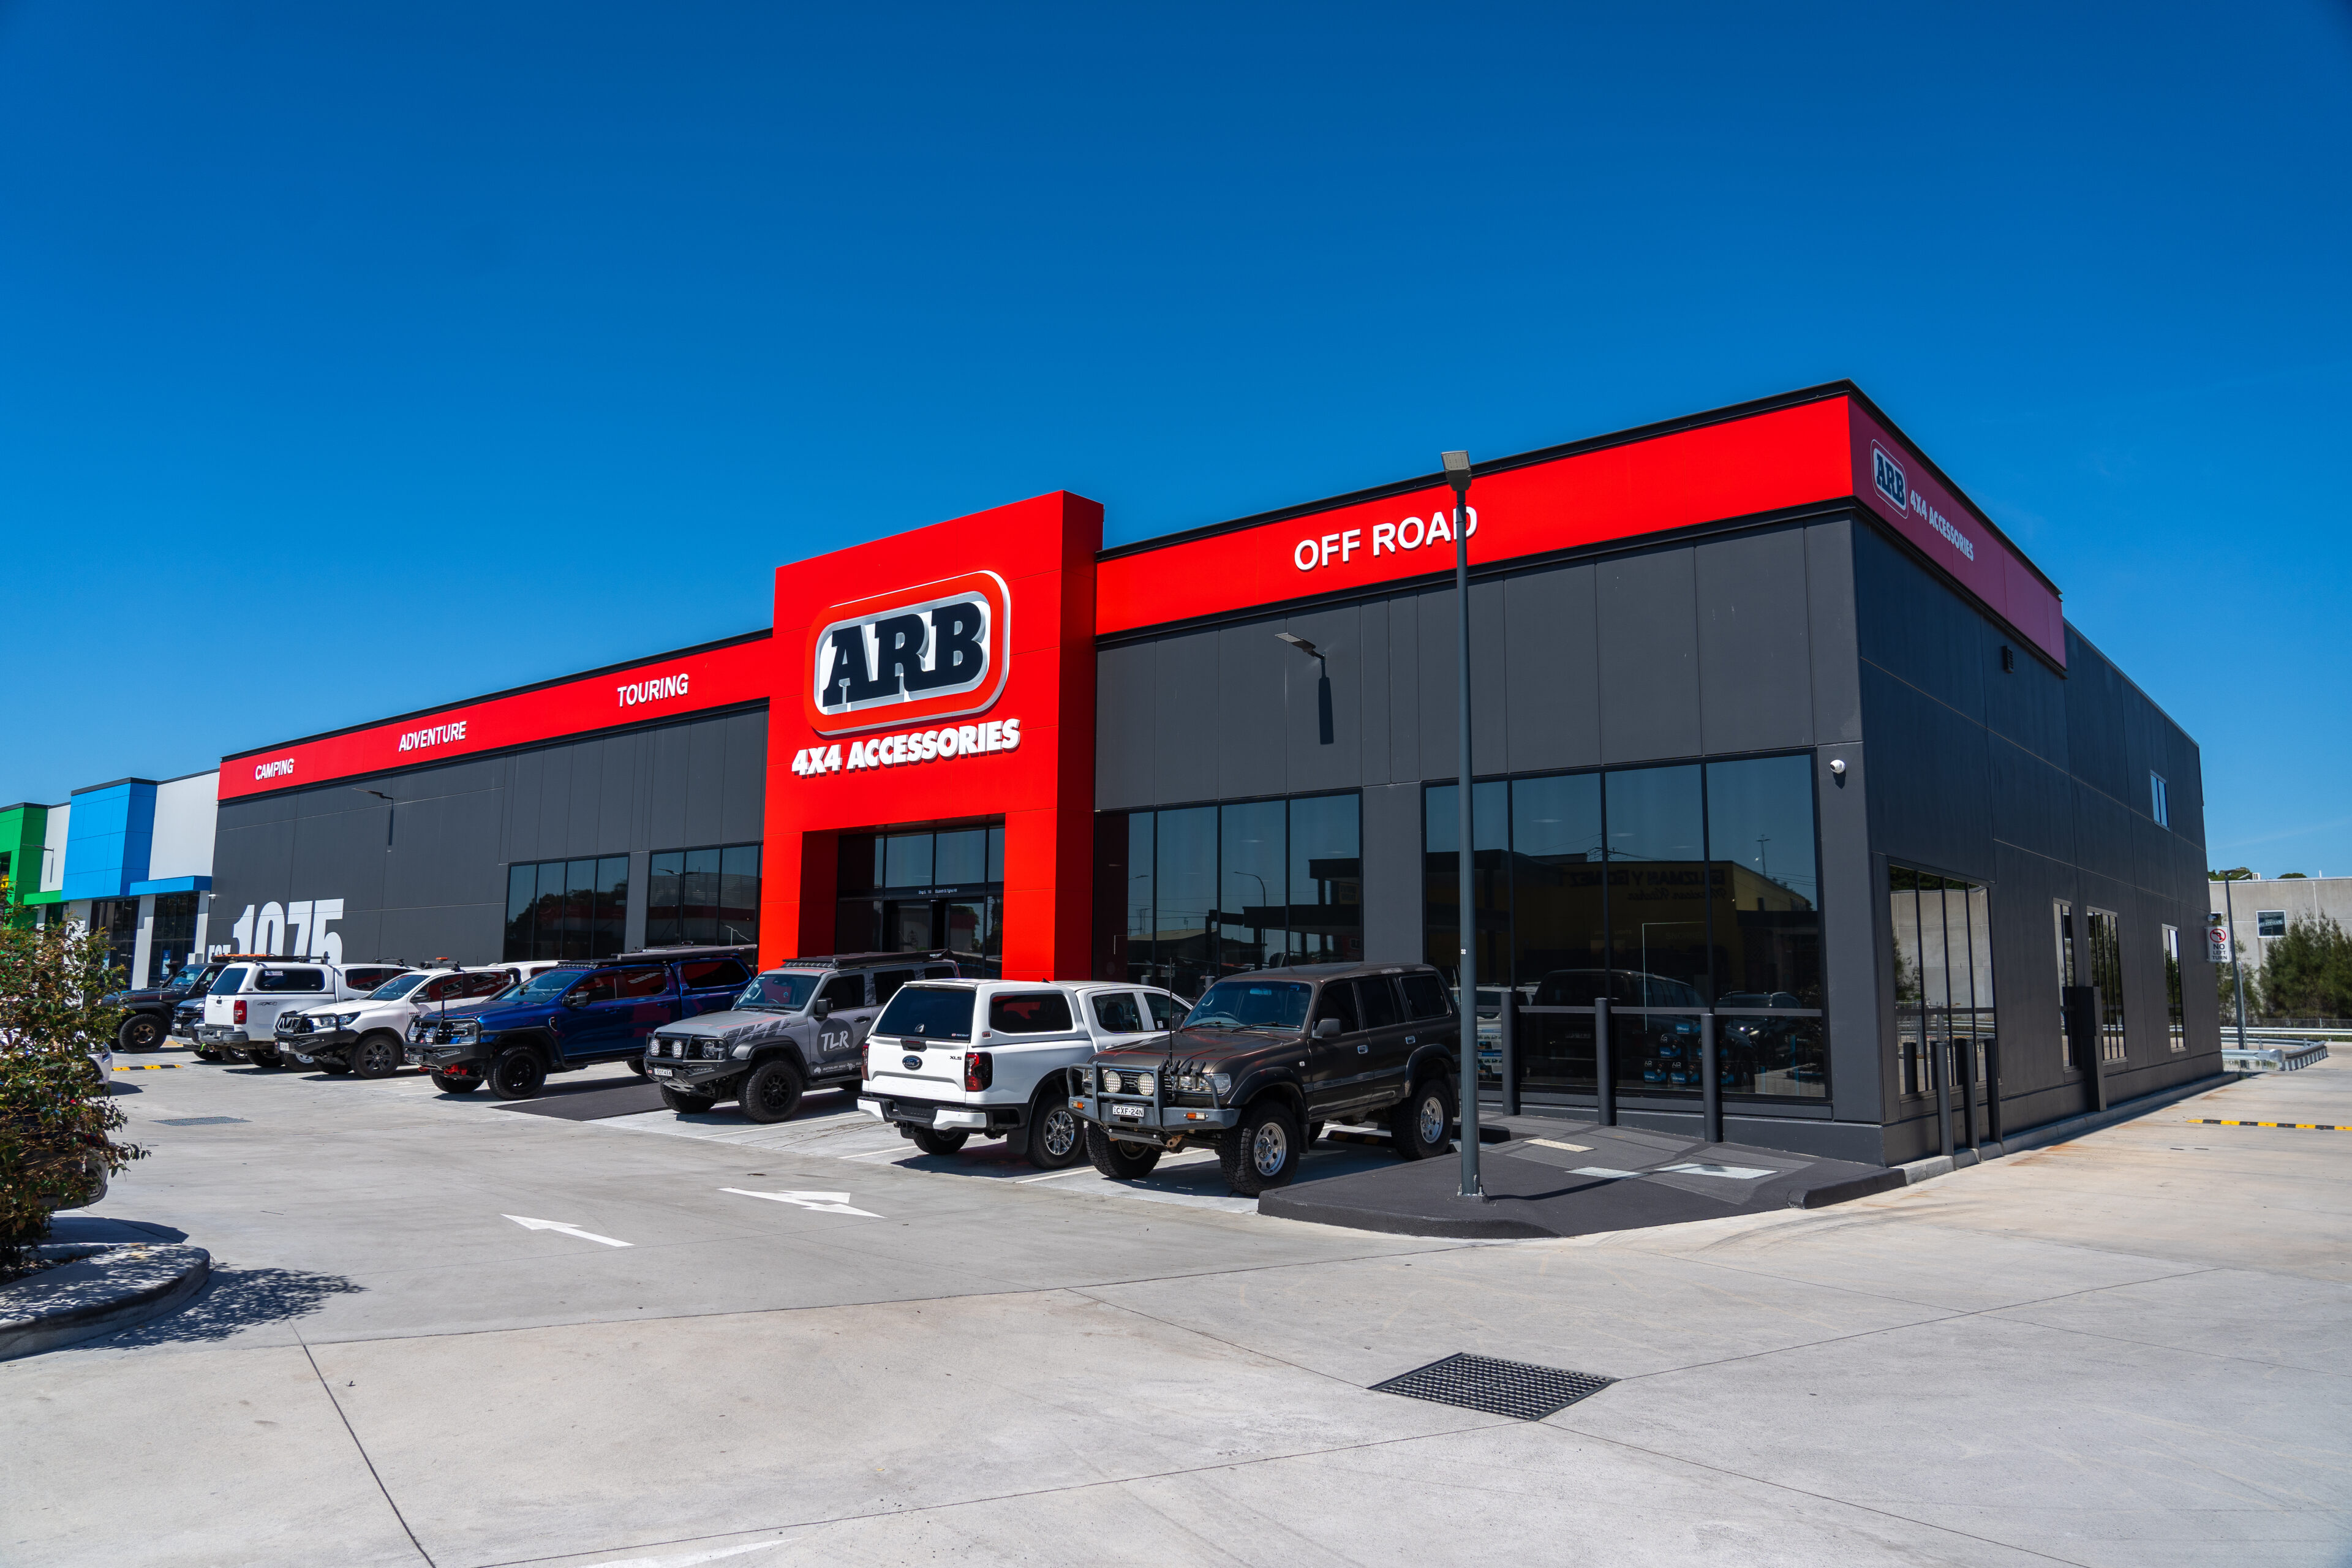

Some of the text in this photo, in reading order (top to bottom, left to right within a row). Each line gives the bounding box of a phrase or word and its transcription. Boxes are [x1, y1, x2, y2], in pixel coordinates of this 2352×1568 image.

[1875, 452, 1906, 507] ARB
[1294, 506, 1477, 571] OFF ROAD
[1910, 489, 1974, 562] 4X4 ACCESSORIES
[822, 601, 984, 708] ARB
[617, 673, 689, 707] TOURING
[398, 720, 467, 752] ADVENTURE
[791, 718, 1021, 776] 4X4 ACCESSORIES
[255, 758, 295, 780] CAMPING
[821, 1030, 850, 1052] TLR
